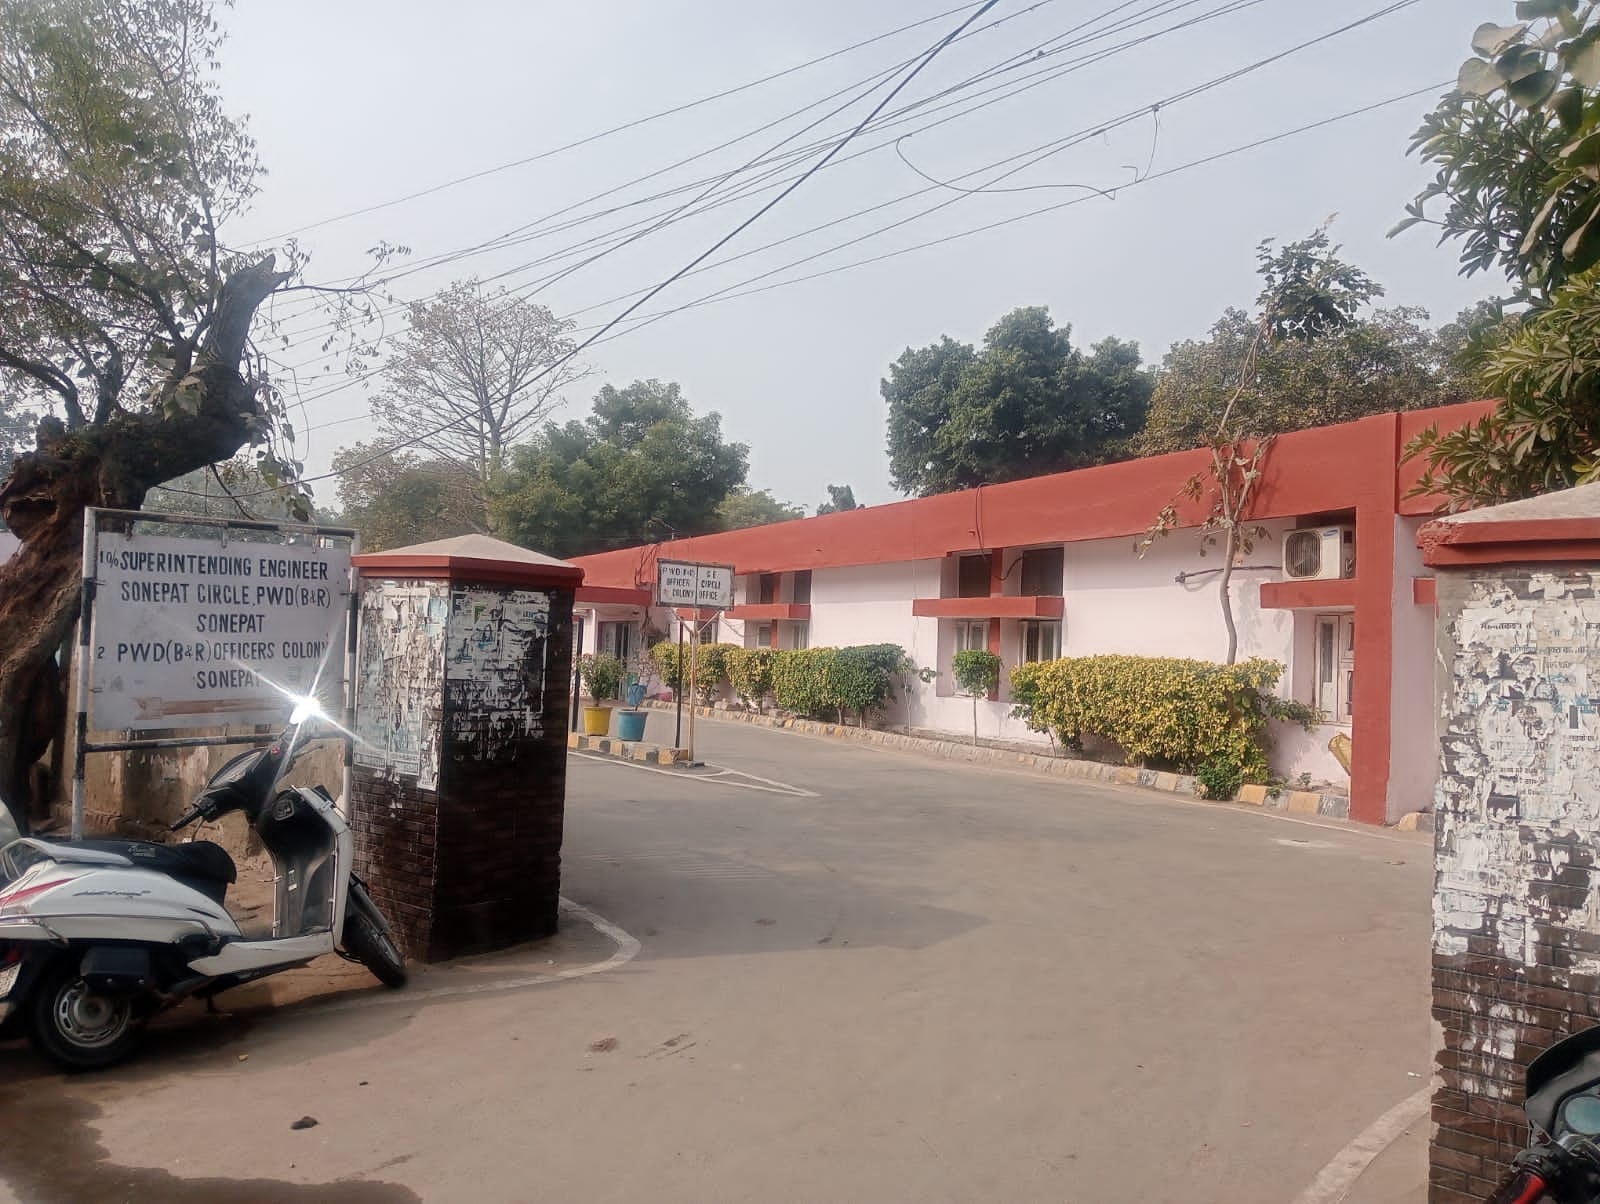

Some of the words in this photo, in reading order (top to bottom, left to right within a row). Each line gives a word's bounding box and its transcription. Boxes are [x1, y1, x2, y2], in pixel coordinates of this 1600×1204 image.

[120, 551, 252, 576] SUPERINTENDING
[259, 558, 329, 580] ENGINEER
[121, 581, 190, 603] SONEPAT
[196, 613, 265, 633] SONEPAT
[97, 646, 105, 660] 2
[213, 641, 276, 661] OFFICERS
[196, 668, 263, 690] SONEPAT
